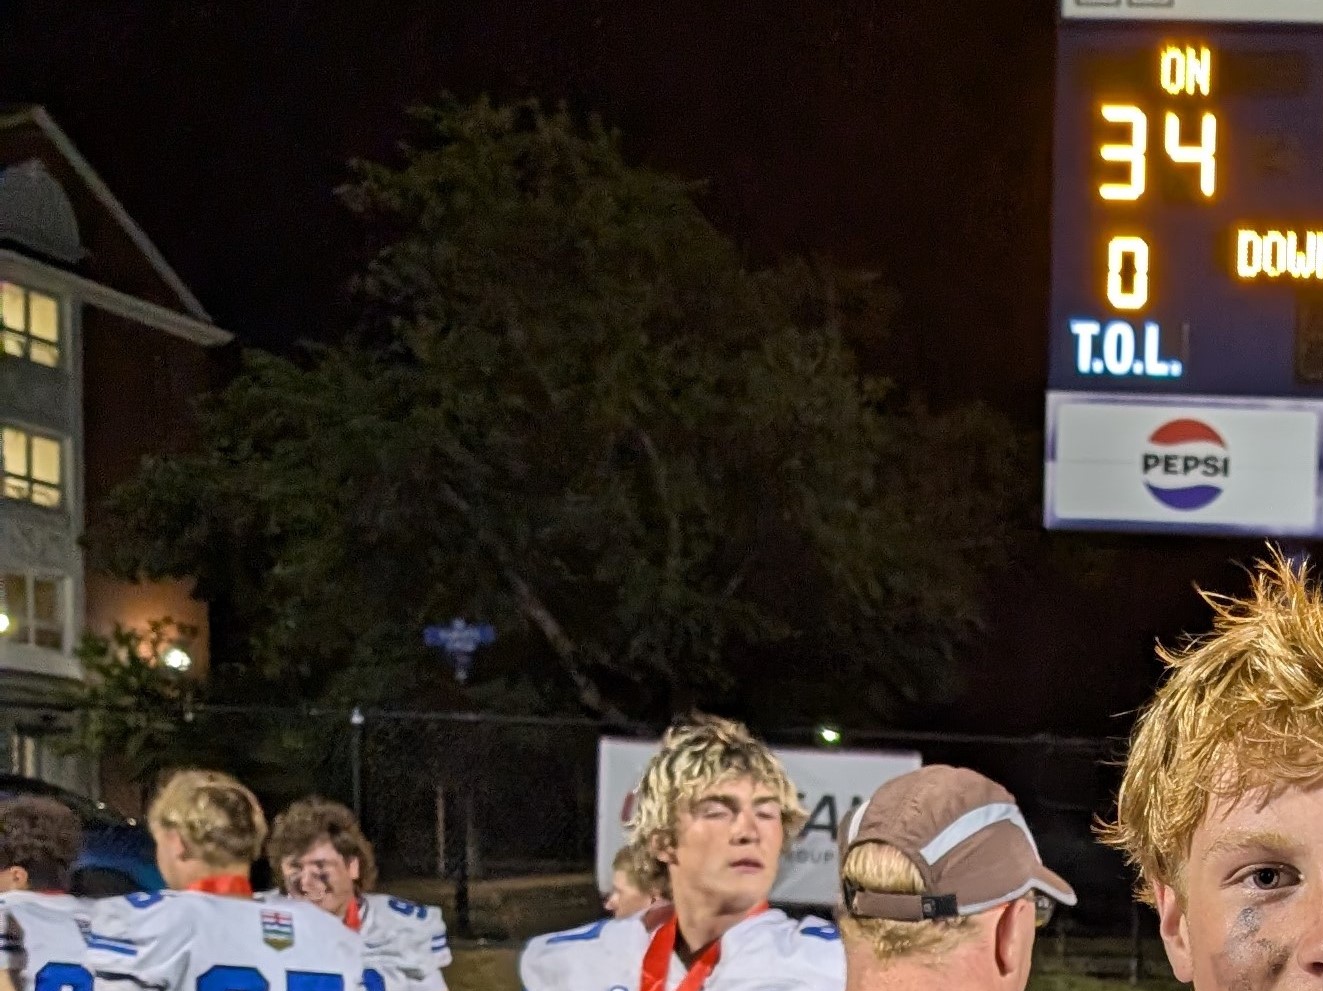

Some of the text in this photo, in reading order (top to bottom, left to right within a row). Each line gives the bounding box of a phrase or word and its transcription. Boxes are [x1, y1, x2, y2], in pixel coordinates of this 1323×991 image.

[1160, 44, 1210, 96] ON
[1099, 104, 1217, 201] 34
[1107, 236, 1149, 310] 0
[1069, 318, 1182, 377] T.O.L.
[1143, 452, 1230, 478] PEPSI
